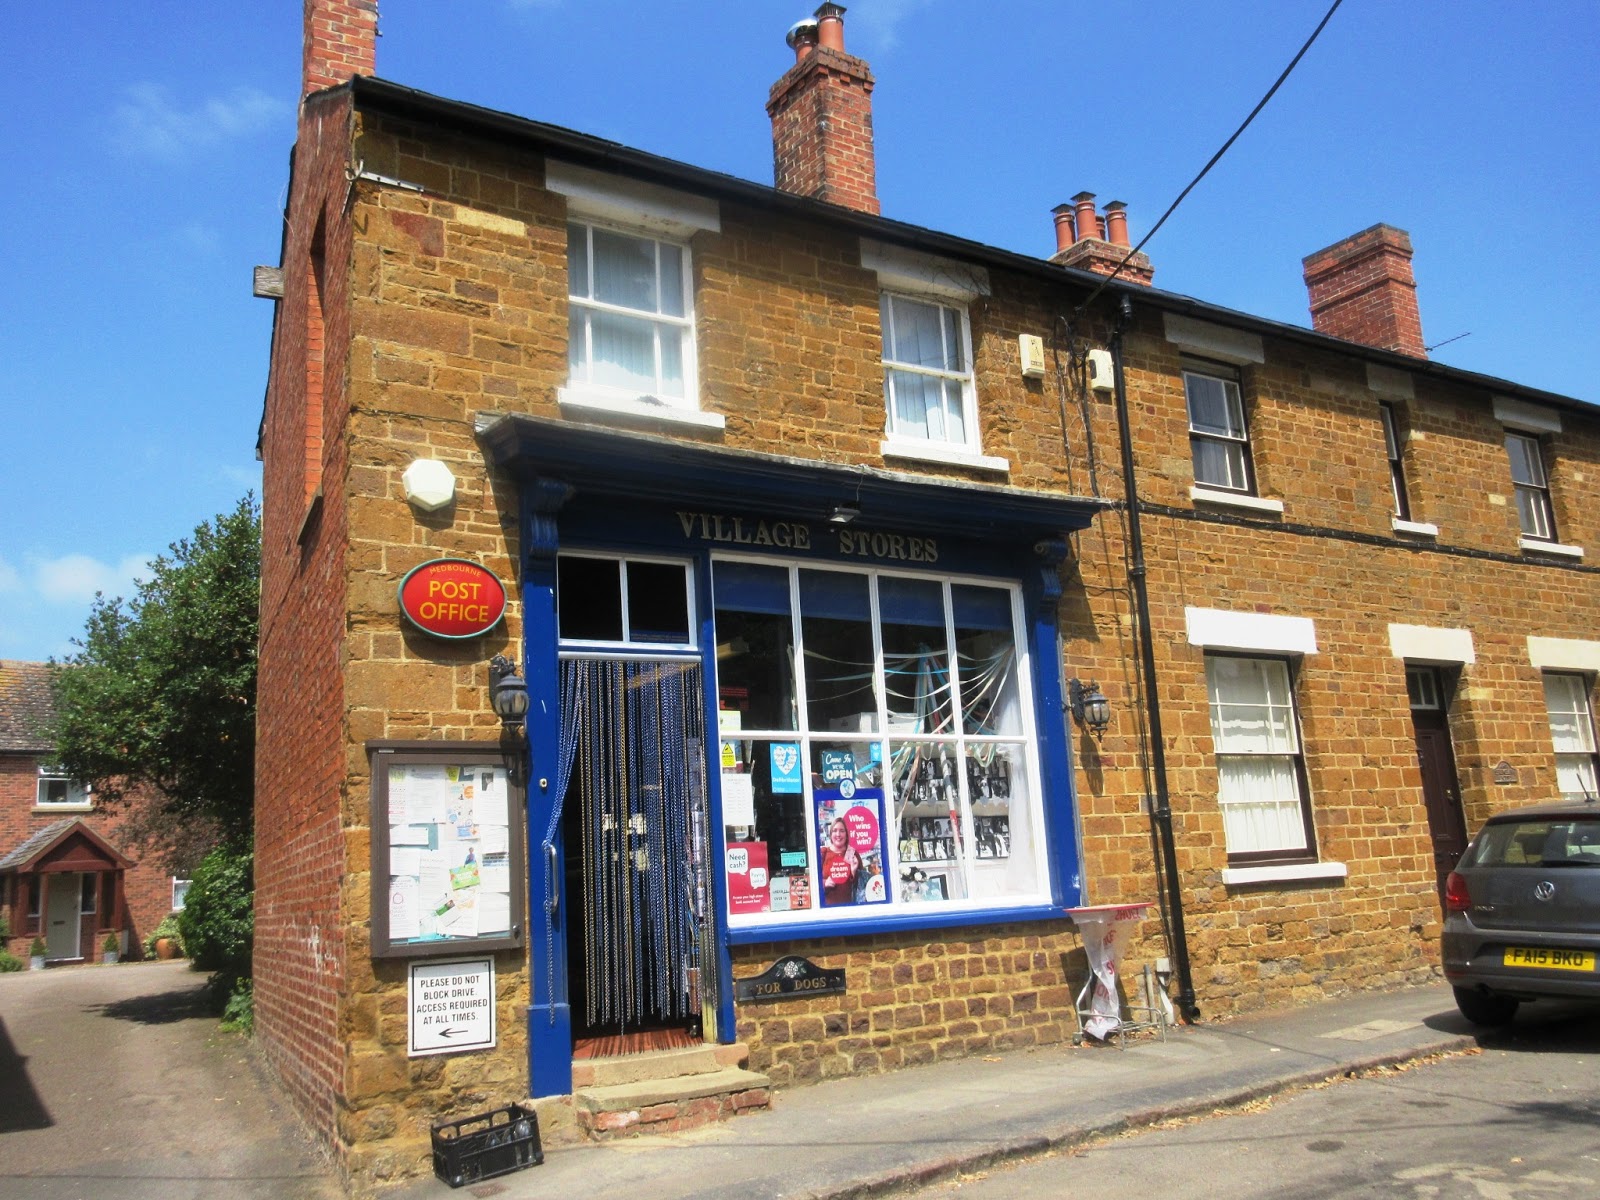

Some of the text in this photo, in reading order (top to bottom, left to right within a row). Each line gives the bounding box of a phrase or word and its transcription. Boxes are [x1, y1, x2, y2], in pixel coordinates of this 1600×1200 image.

[677, 510, 939, 563] VILLAGE STORES
[429, 564, 482, 578] MEDBOURNE
[429, 580, 482, 600] POST
[419, 602, 489, 623] OFFICE
[825, 753, 842, 765] Come
[826, 769, 853, 780] OPEN
[848, 814, 865, 822] Who
[855, 822, 871, 830] wins
[850, 830, 869, 840] if you
[856, 837, 872, 845] win?
[729, 861, 746, 869] cash?
[831, 871, 848, 879] ticket
[1512, 949, 1584, 967] FA15 BKO
[420, 975, 480, 988] PLEASE DO NOT
[756, 976, 827, 995] FOR DOGS
[423, 987, 478, 1001] BLOCK DRIVE.
[416, 999, 488, 1013] ACCESS REQUIRED
[423, 1012, 479, 1025] AT ALL TIMES.
